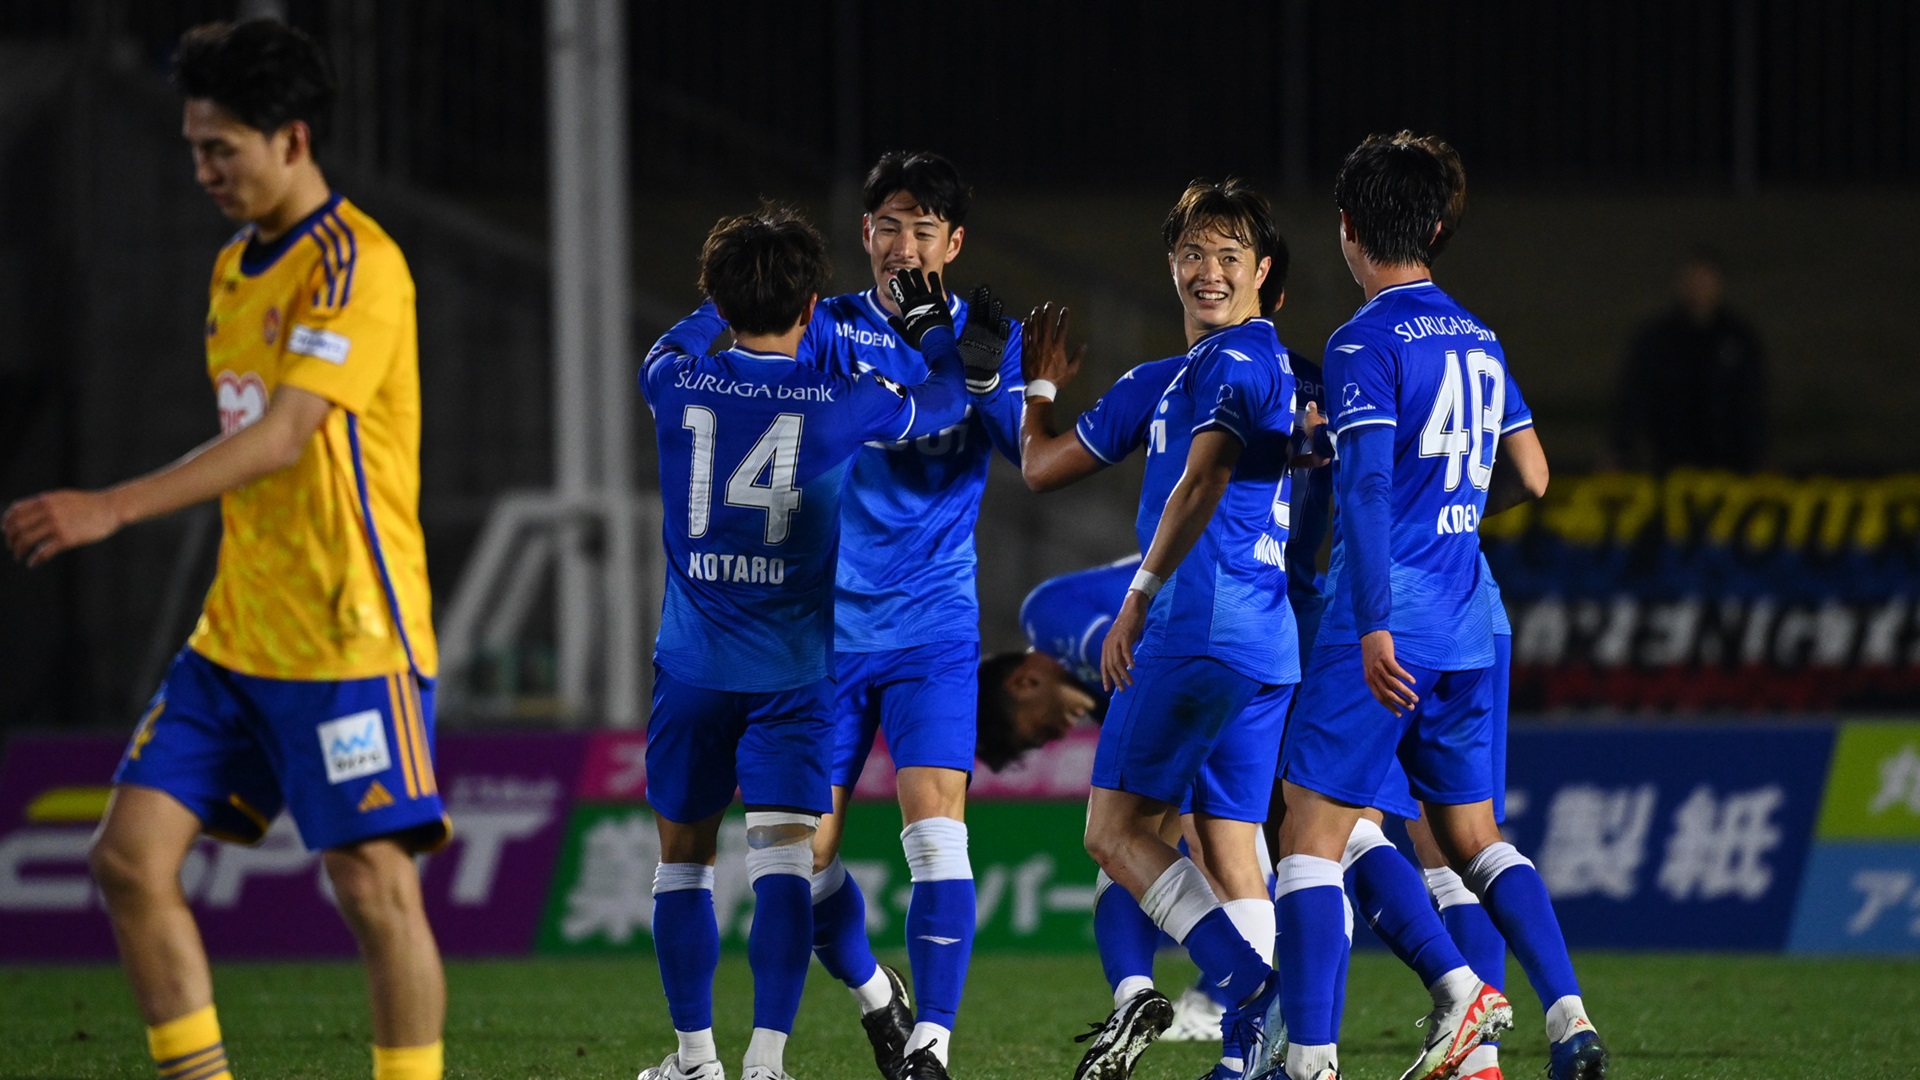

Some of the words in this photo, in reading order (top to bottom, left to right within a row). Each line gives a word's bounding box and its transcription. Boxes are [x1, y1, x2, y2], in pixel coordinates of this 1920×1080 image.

[835, 321, 896, 349] MEIDEN
[1394, 316, 1464, 343] SURUGA
[674, 370, 772, 399] SURUGA
[776, 384, 835, 402] bank
[682, 404, 804, 546] 14
[688, 551, 785, 585] KOTARO
[1503, 784, 1786, 899] 製紙
